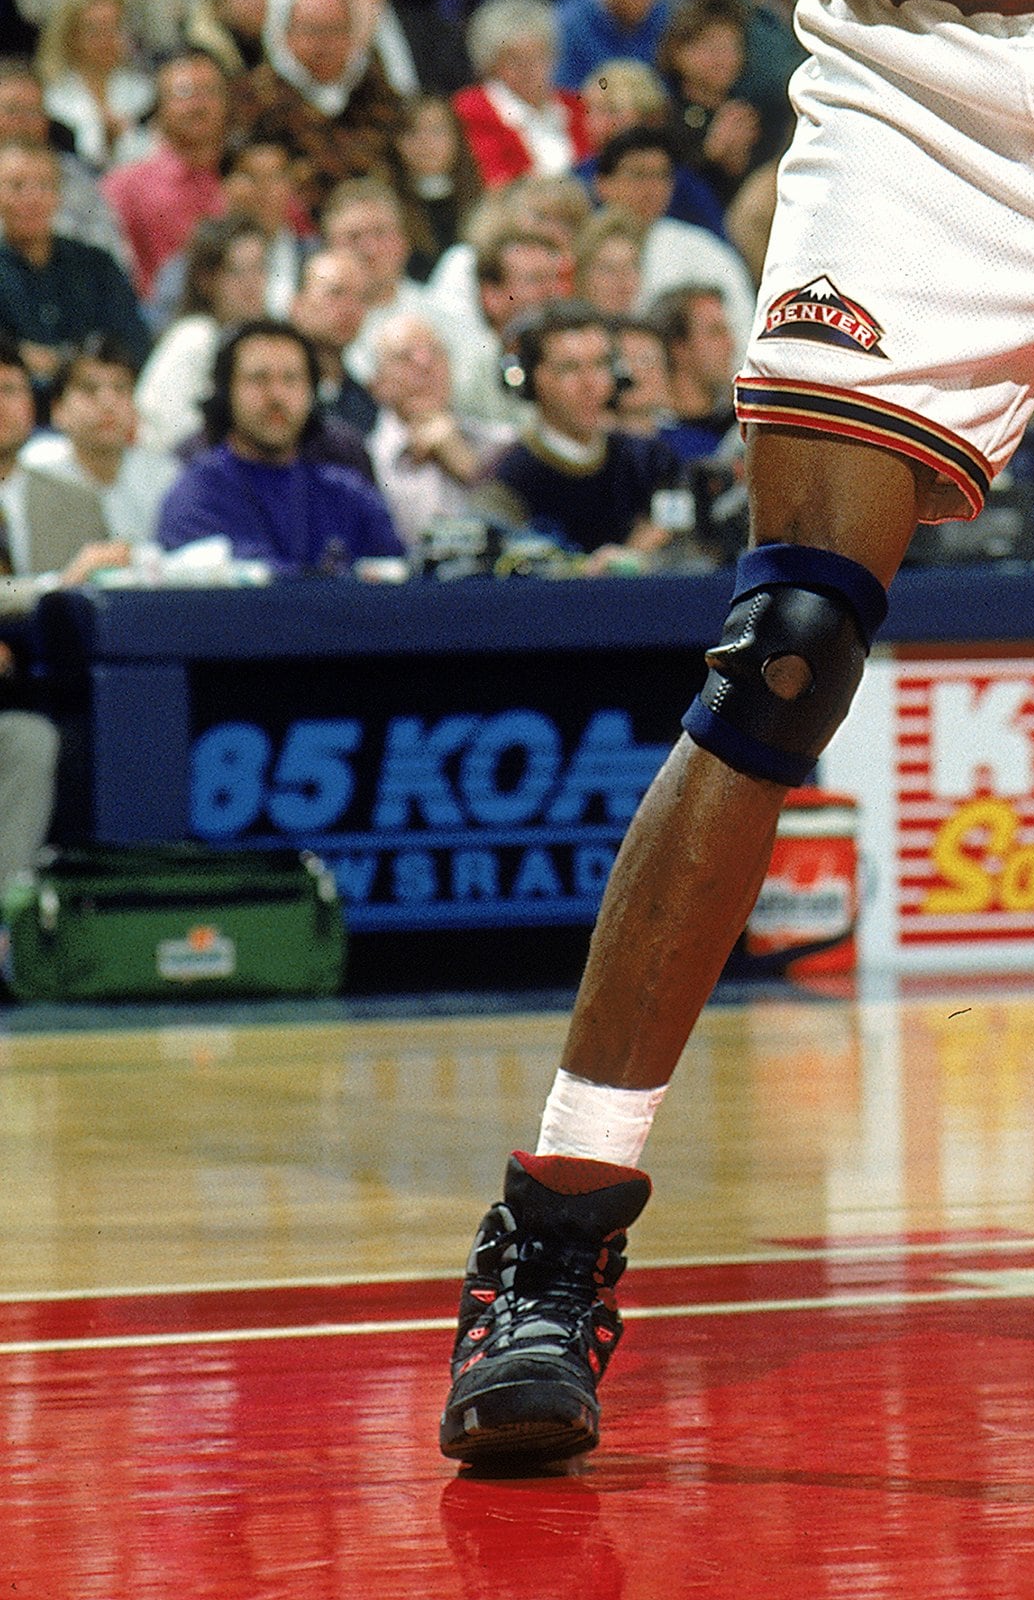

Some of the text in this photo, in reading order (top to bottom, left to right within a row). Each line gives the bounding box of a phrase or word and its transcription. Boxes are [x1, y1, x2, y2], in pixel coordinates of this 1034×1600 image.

[768, 302, 874, 348] DENVER
[190, 708, 660, 838] 85 KOA
